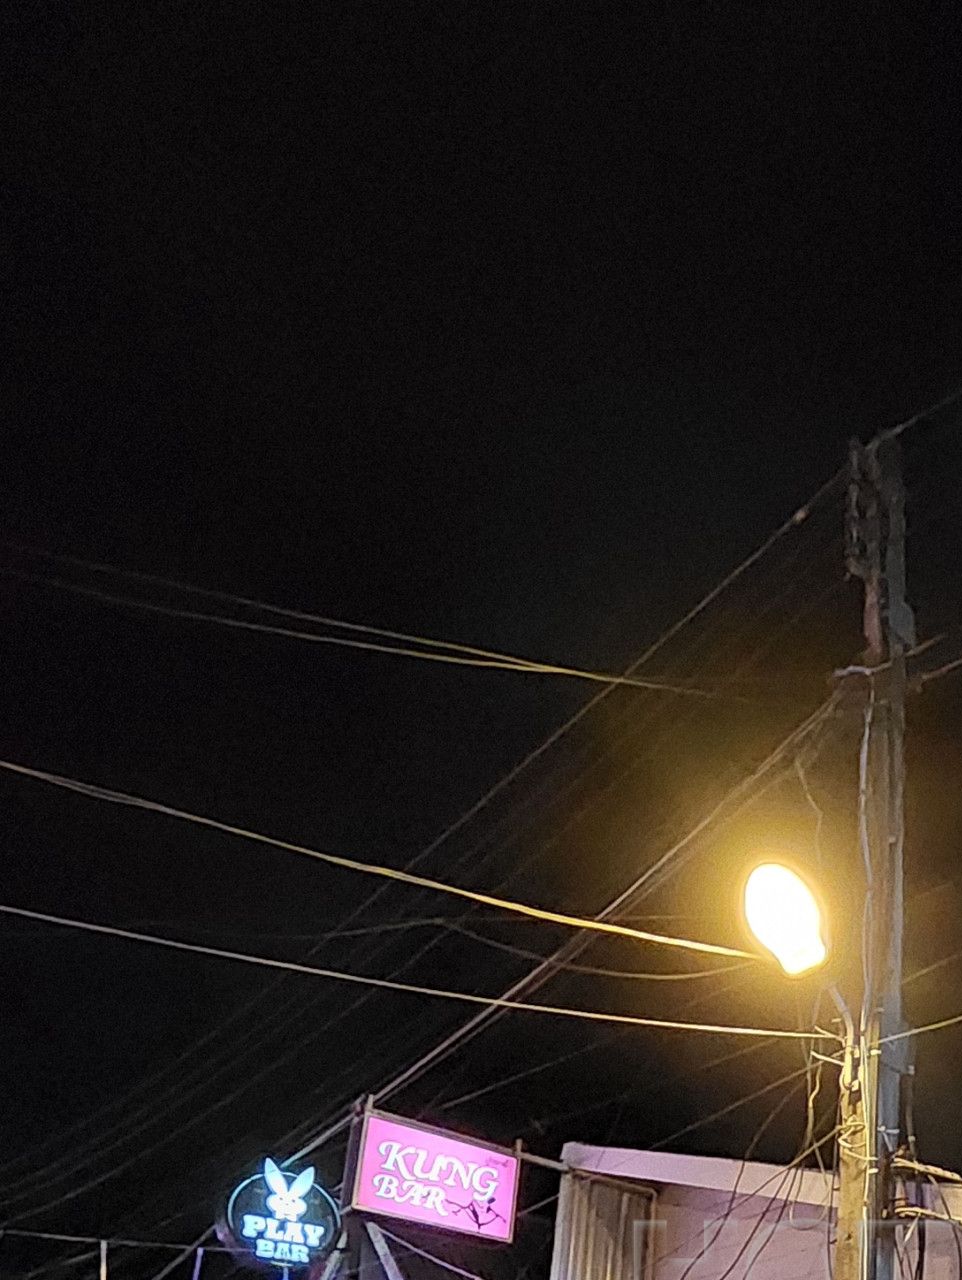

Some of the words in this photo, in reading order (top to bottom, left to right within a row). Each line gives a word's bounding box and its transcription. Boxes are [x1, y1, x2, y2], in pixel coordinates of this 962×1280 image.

[378, 1141, 499, 1202] KUNG
[372, 1173, 449, 1217] BAR
[242, 1214, 325, 1248] PLAY
[255, 1238, 310, 1263] BAR
